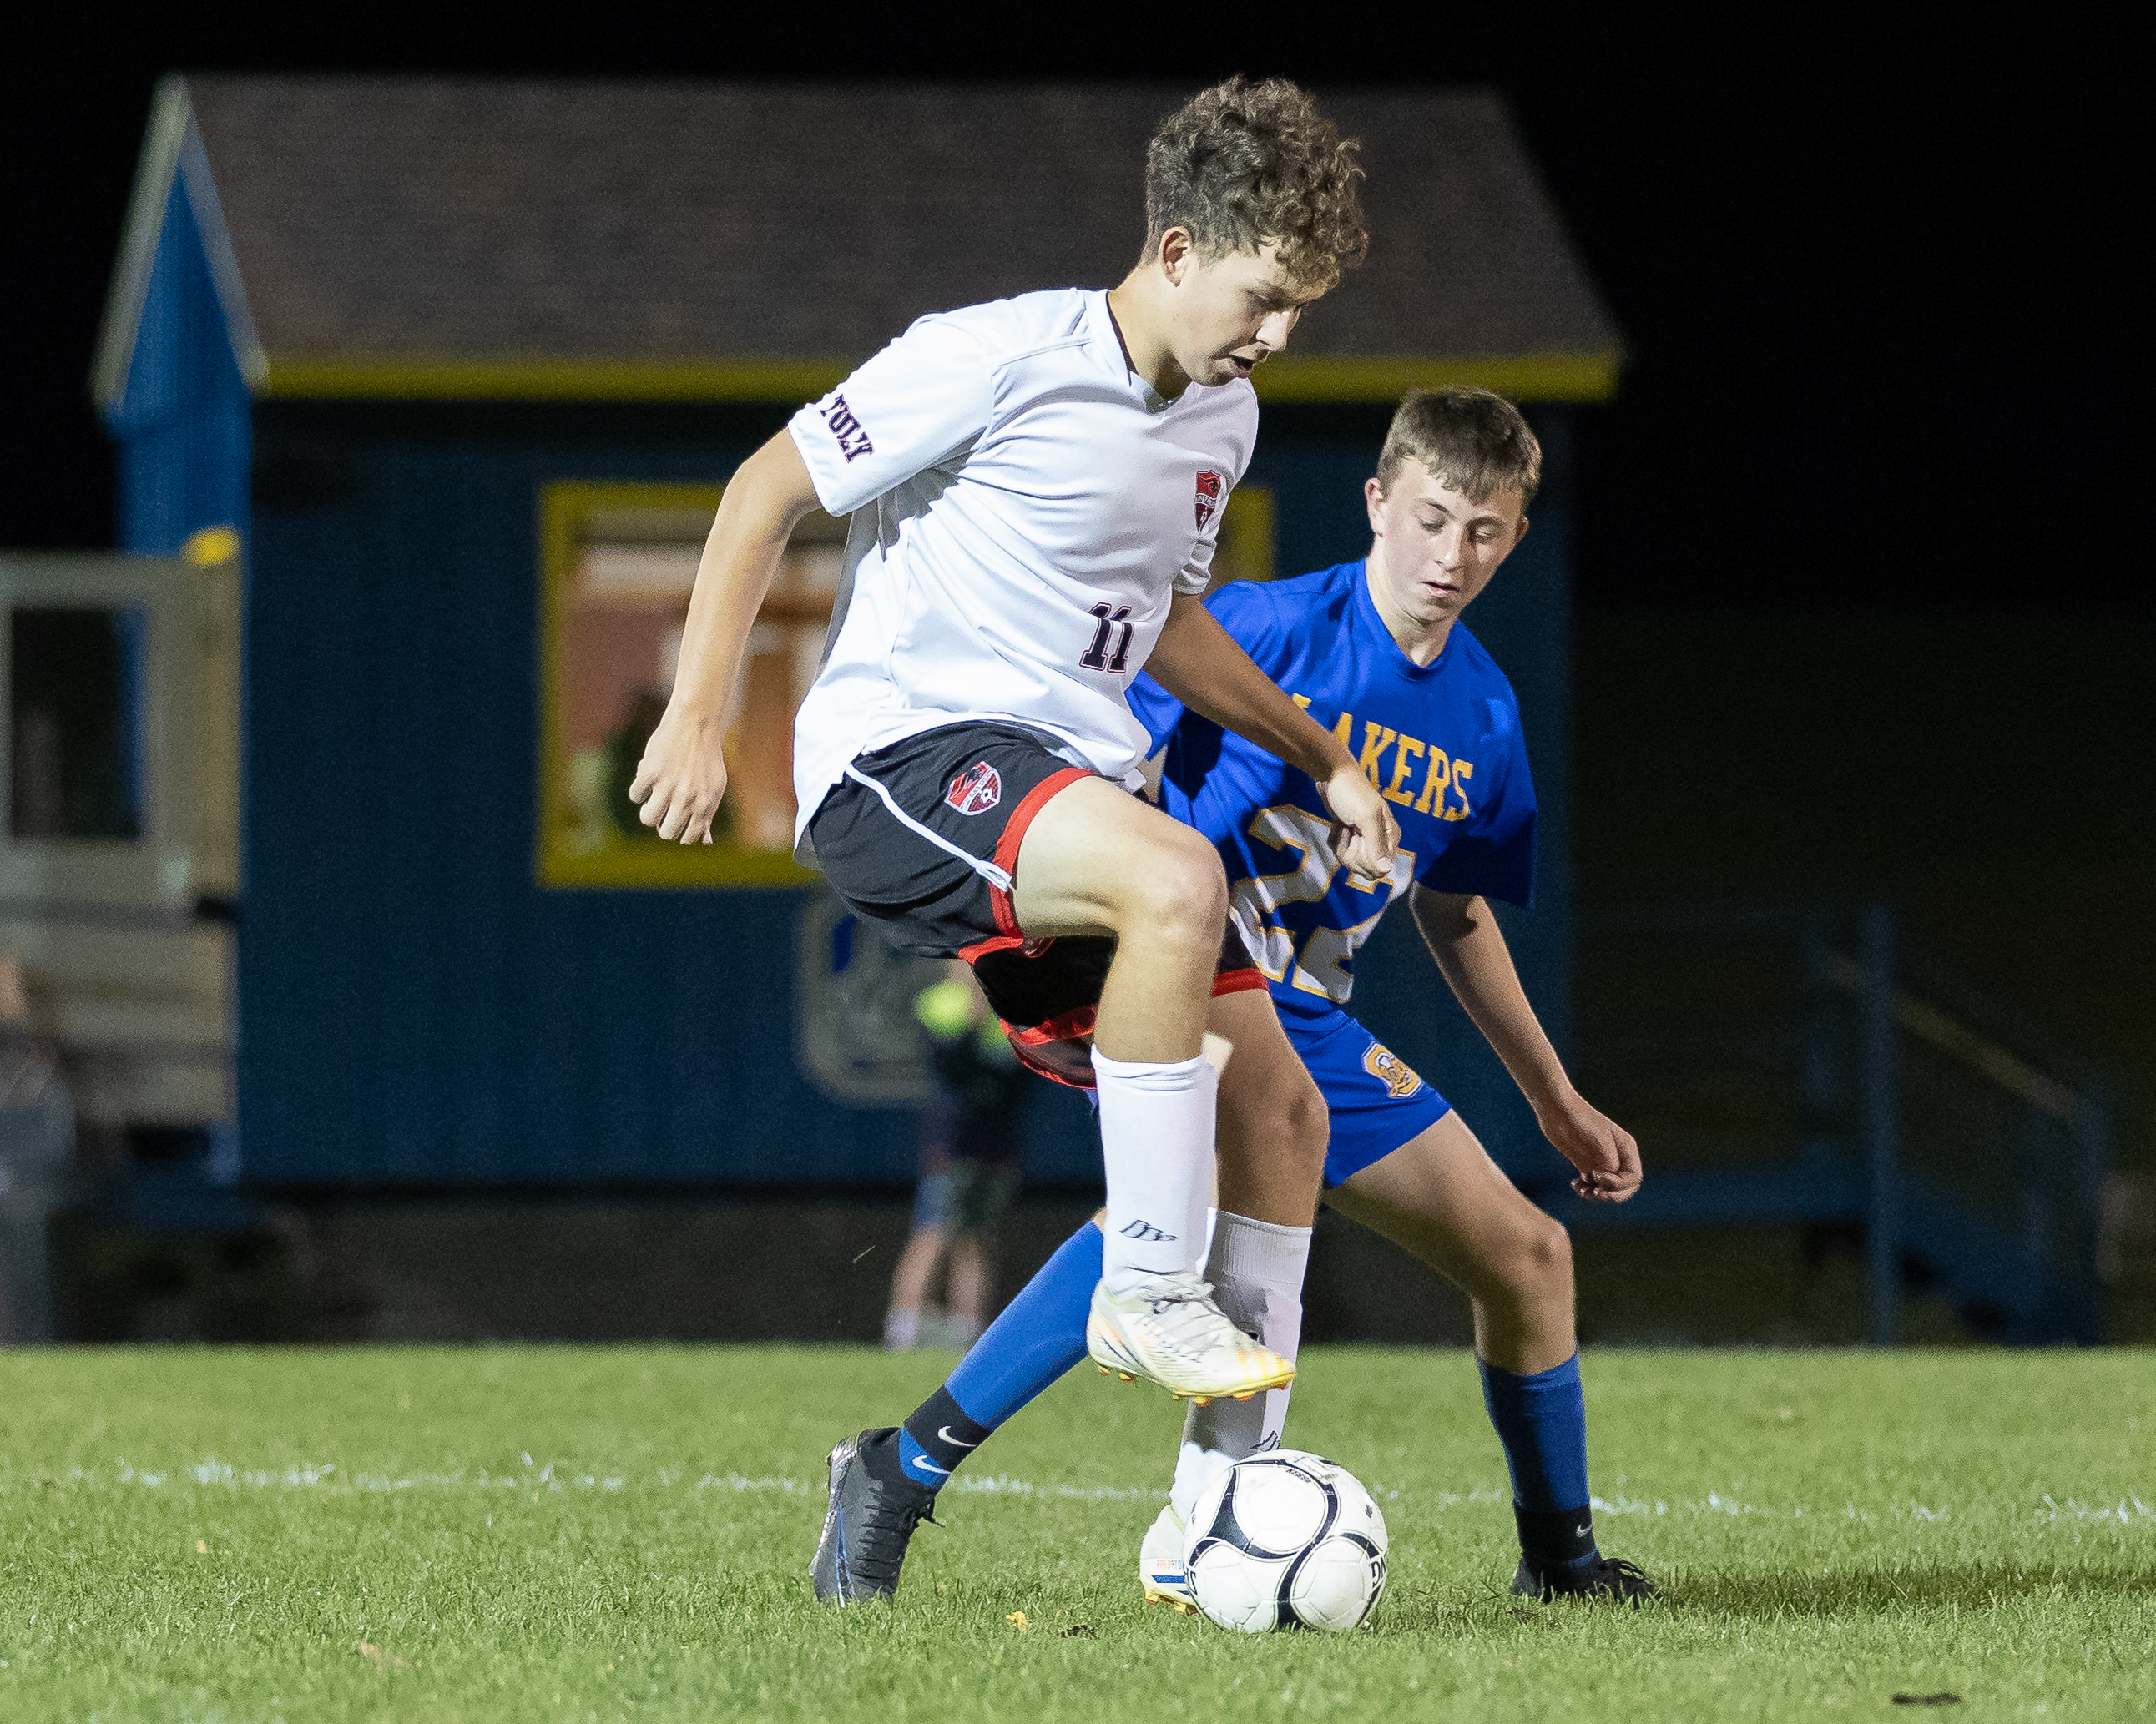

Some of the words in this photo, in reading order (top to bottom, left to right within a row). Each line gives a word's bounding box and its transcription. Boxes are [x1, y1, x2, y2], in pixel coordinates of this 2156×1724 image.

[1079, 602, 1134, 673] 11
[1293, 693, 1474, 822] AKERS
[1231, 803, 1417, 1004] 22
